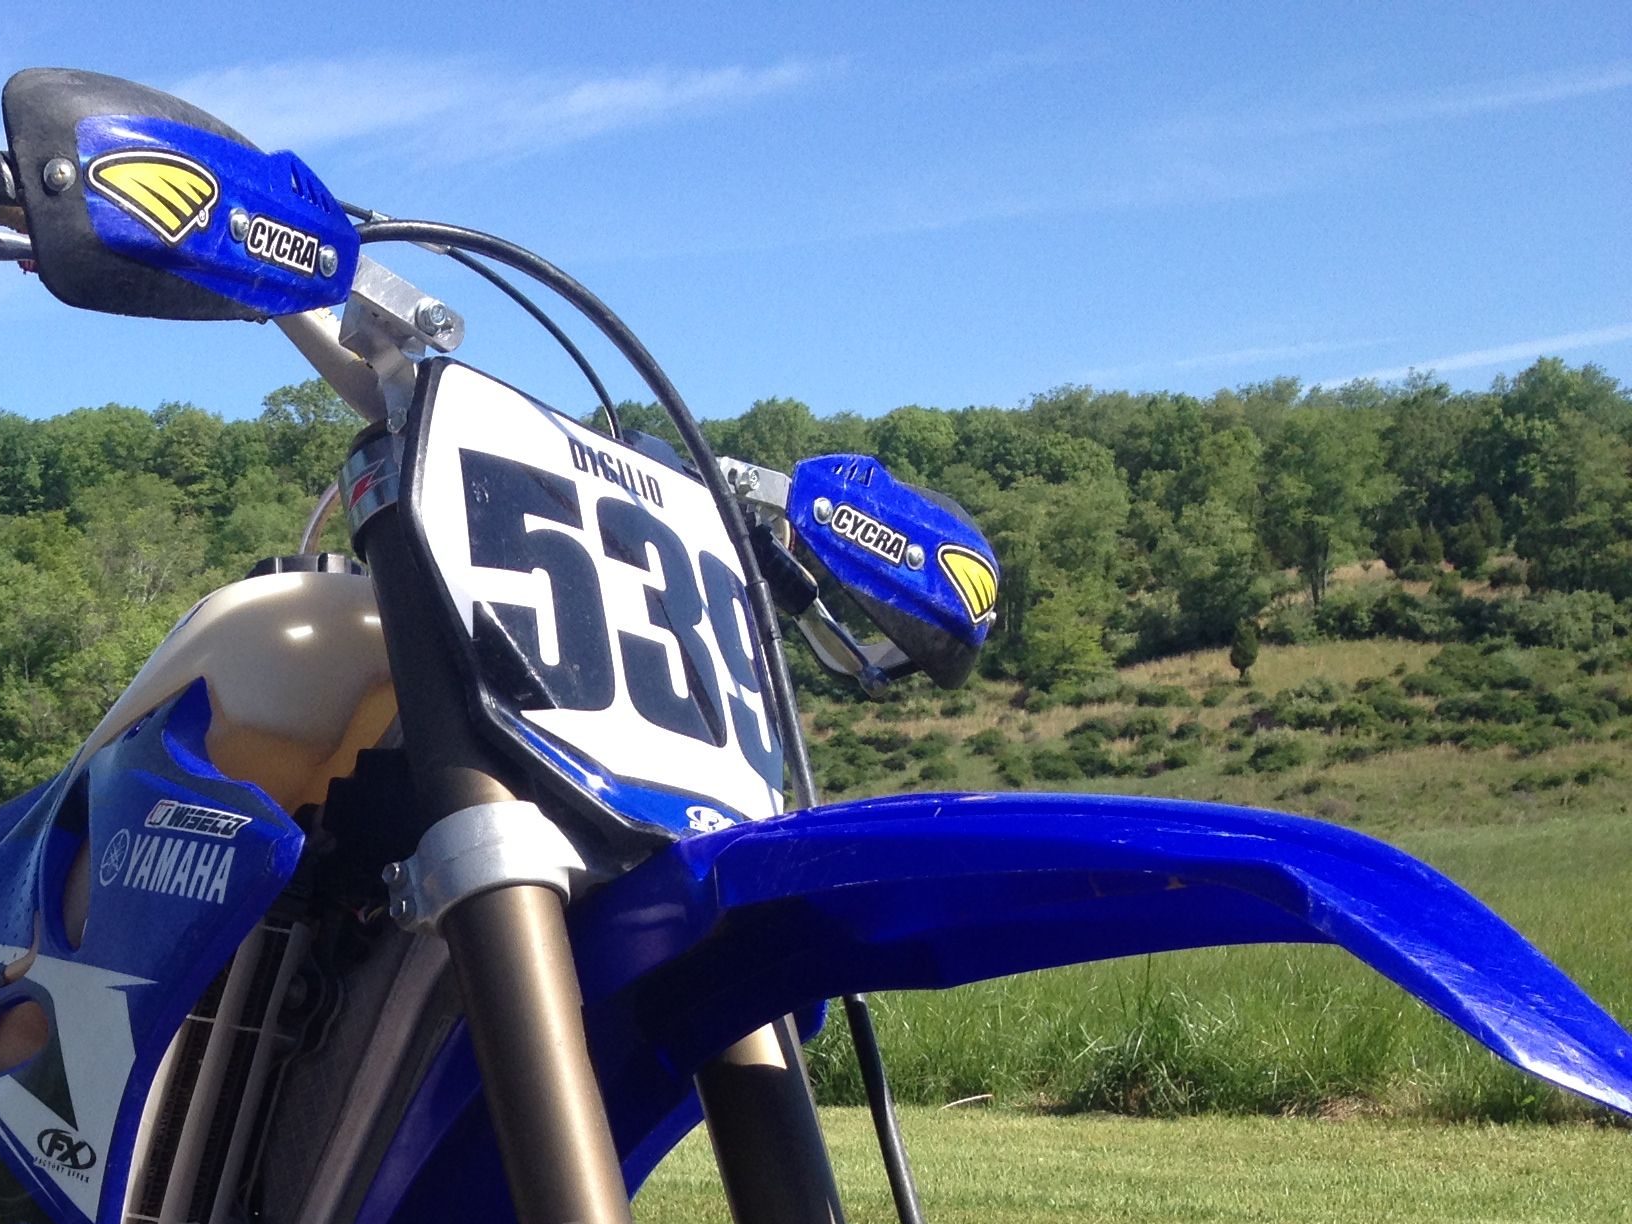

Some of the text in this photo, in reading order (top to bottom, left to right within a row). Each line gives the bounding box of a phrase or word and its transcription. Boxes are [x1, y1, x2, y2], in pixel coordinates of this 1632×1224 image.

[249, 221, 317, 269] CYCRA
[833, 508, 904, 564] CYCRA
[458, 447, 784, 797] 539
[123, 833, 236, 904] YAMAHA
